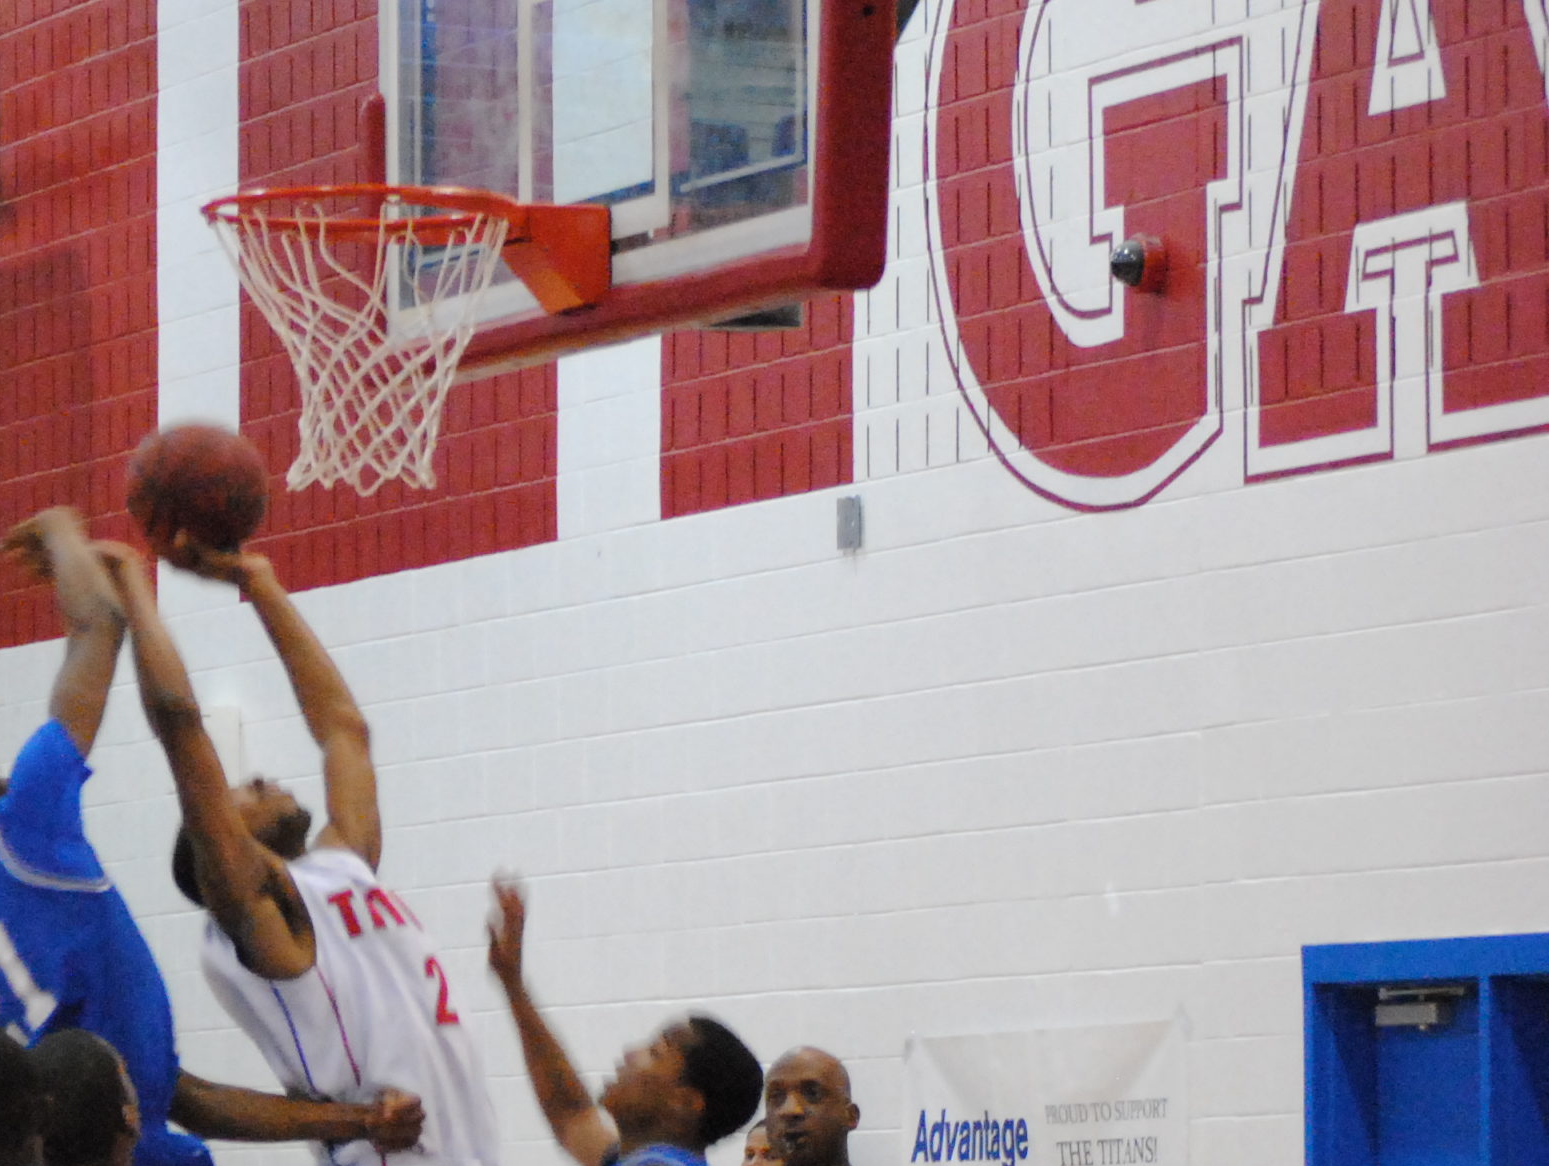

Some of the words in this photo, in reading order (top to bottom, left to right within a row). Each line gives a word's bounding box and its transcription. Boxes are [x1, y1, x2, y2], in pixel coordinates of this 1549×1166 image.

[424, 956, 459, 1026] 2
[1045, 1104, 1088, 1124] PROUD
[1089, 1102, 1112, 1122] TO
[1114, 1098, 1168, 1120] SUPPORT
[1096, 1136, 1158, 1166] TITANS!
